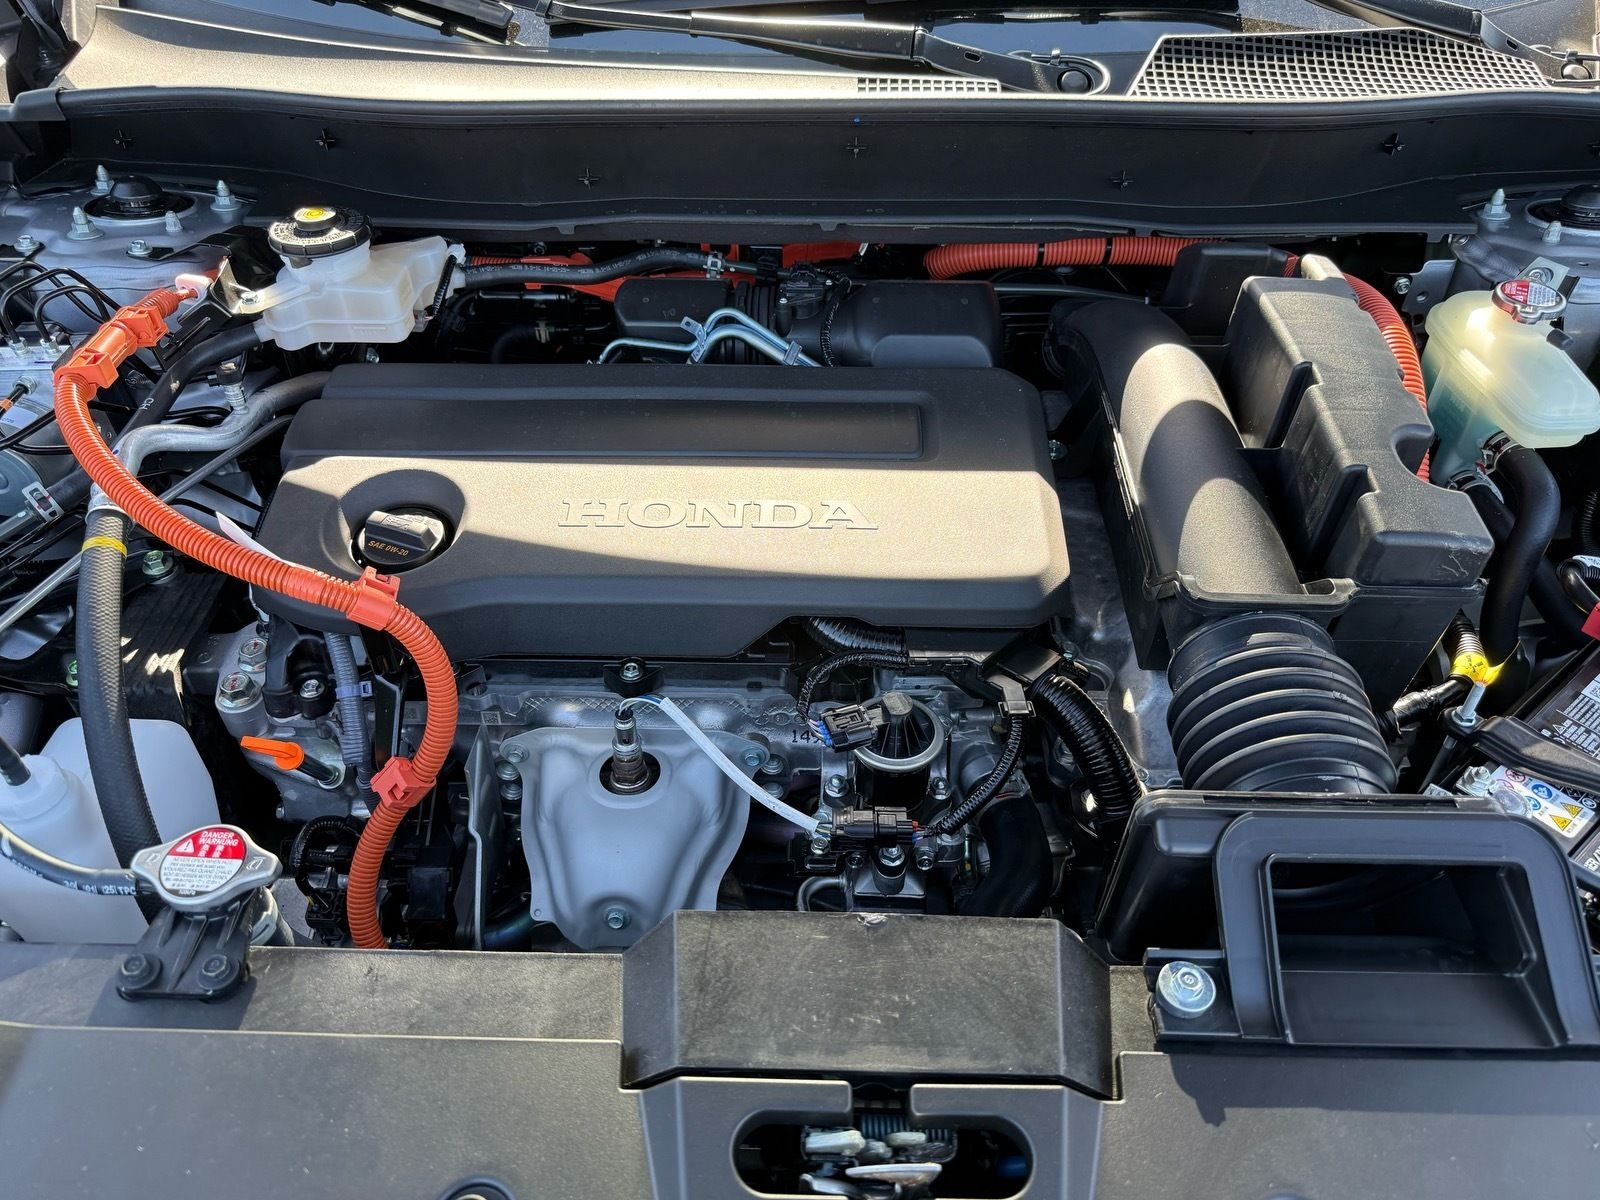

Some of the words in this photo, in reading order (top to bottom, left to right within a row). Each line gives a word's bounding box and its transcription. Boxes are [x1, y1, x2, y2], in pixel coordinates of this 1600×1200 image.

[558, 499, 878, 530] HONDA
[368, 540, 386, 550] SAE
[385, 545, 409, 556] 0W-20
[201, 831, 234, 839] DANGER
[199, 838, 239, 846] WARNUNG
[117, 886, 137, 895] TPC
